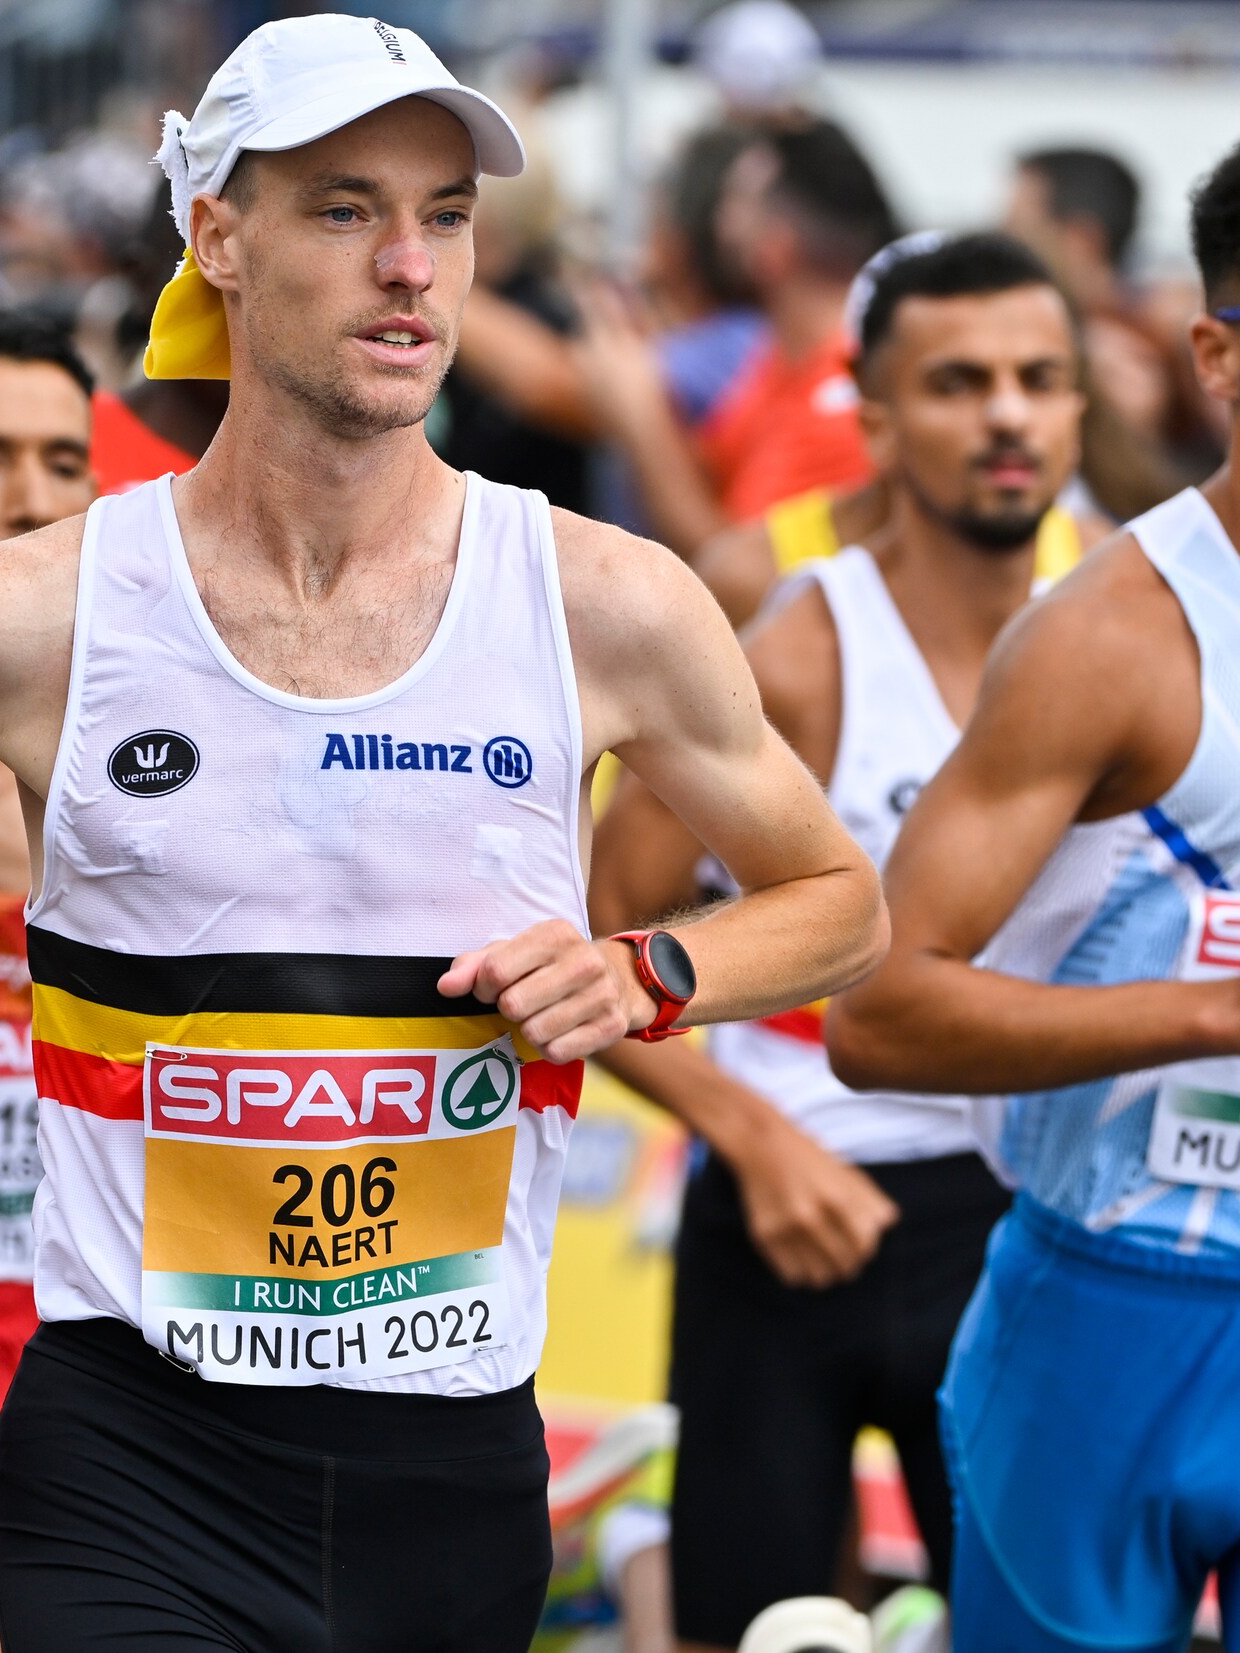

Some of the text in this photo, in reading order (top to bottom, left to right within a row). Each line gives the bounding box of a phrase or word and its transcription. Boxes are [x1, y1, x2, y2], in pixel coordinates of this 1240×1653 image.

[121, 769, 184, 784] vermarc
[320, 733, 473, 774] Allianz
[158, 1064, 426, 1128] SPAR
[271, 1156, 398, 1228] 206
[269, 1220, 399, 1268] NAERT
[234, 1280, 241, 1307] I
[253, 1280, 321, 1311] RUN
[166, 1300, 492, 1370] MUNICH 2022
